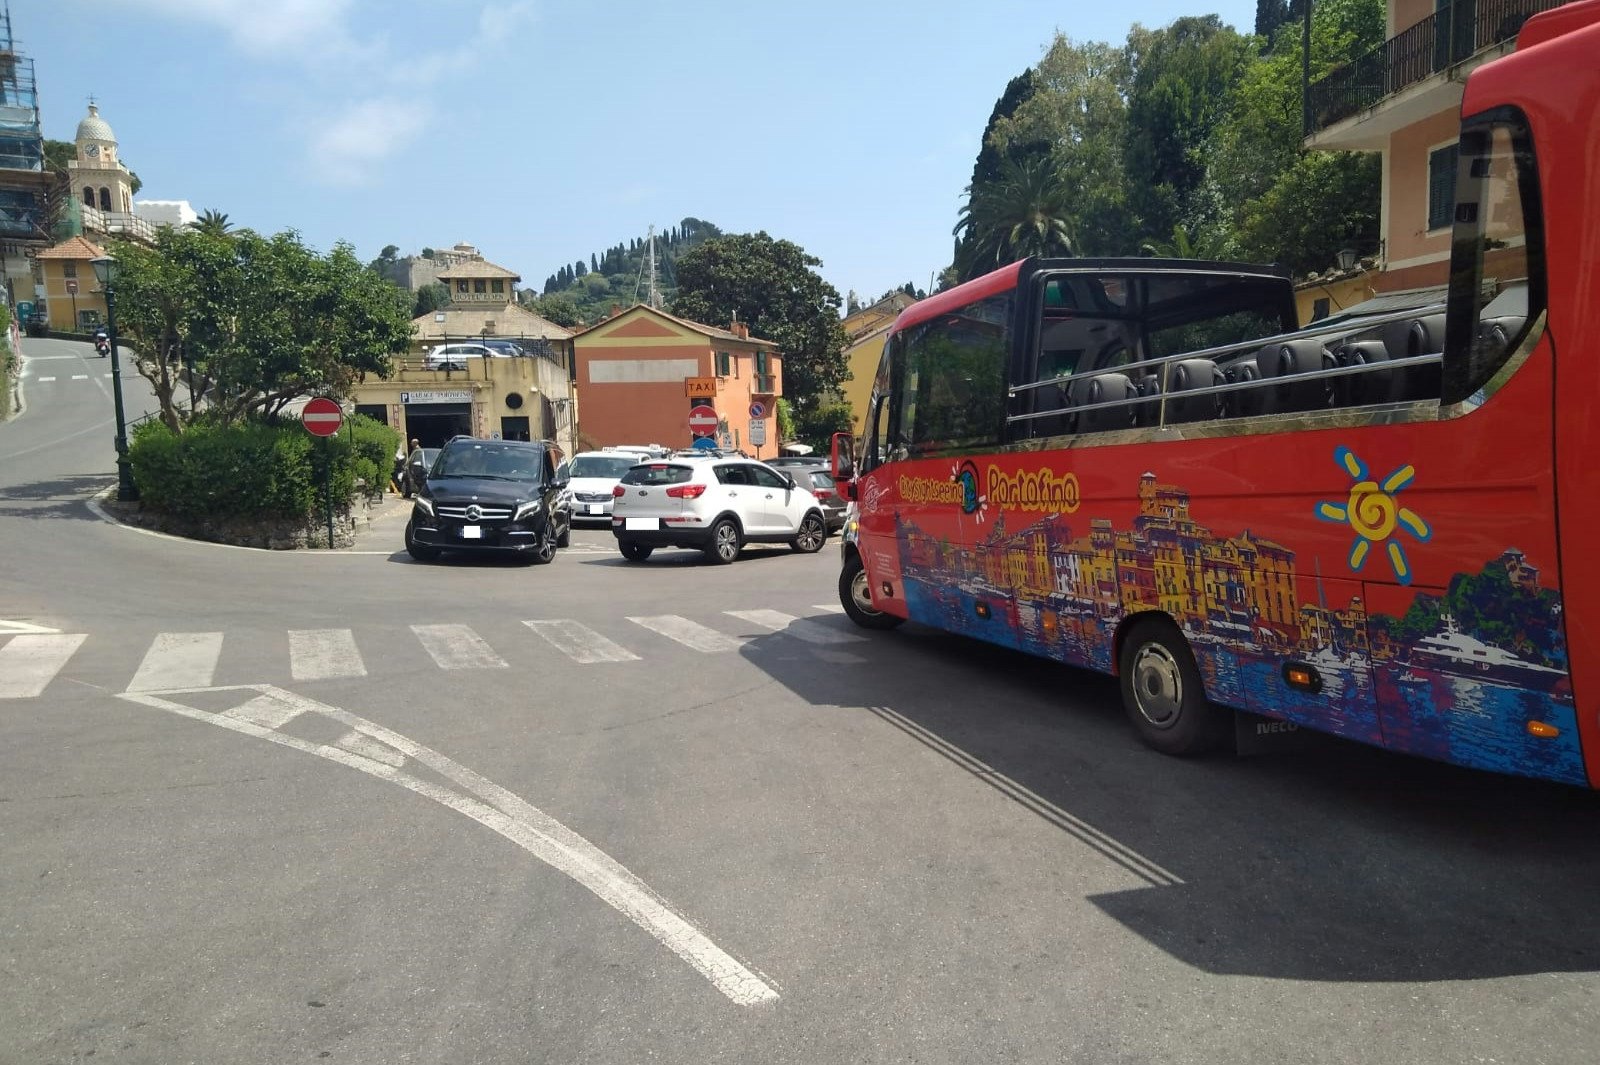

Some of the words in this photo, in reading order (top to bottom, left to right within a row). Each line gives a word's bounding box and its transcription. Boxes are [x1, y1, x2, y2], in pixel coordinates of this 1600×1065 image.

[688, 383, 714, 391] TAXI
[987, 464, 1080, 513] Portofino
[1256, 721, 1298, 735] IVECO
